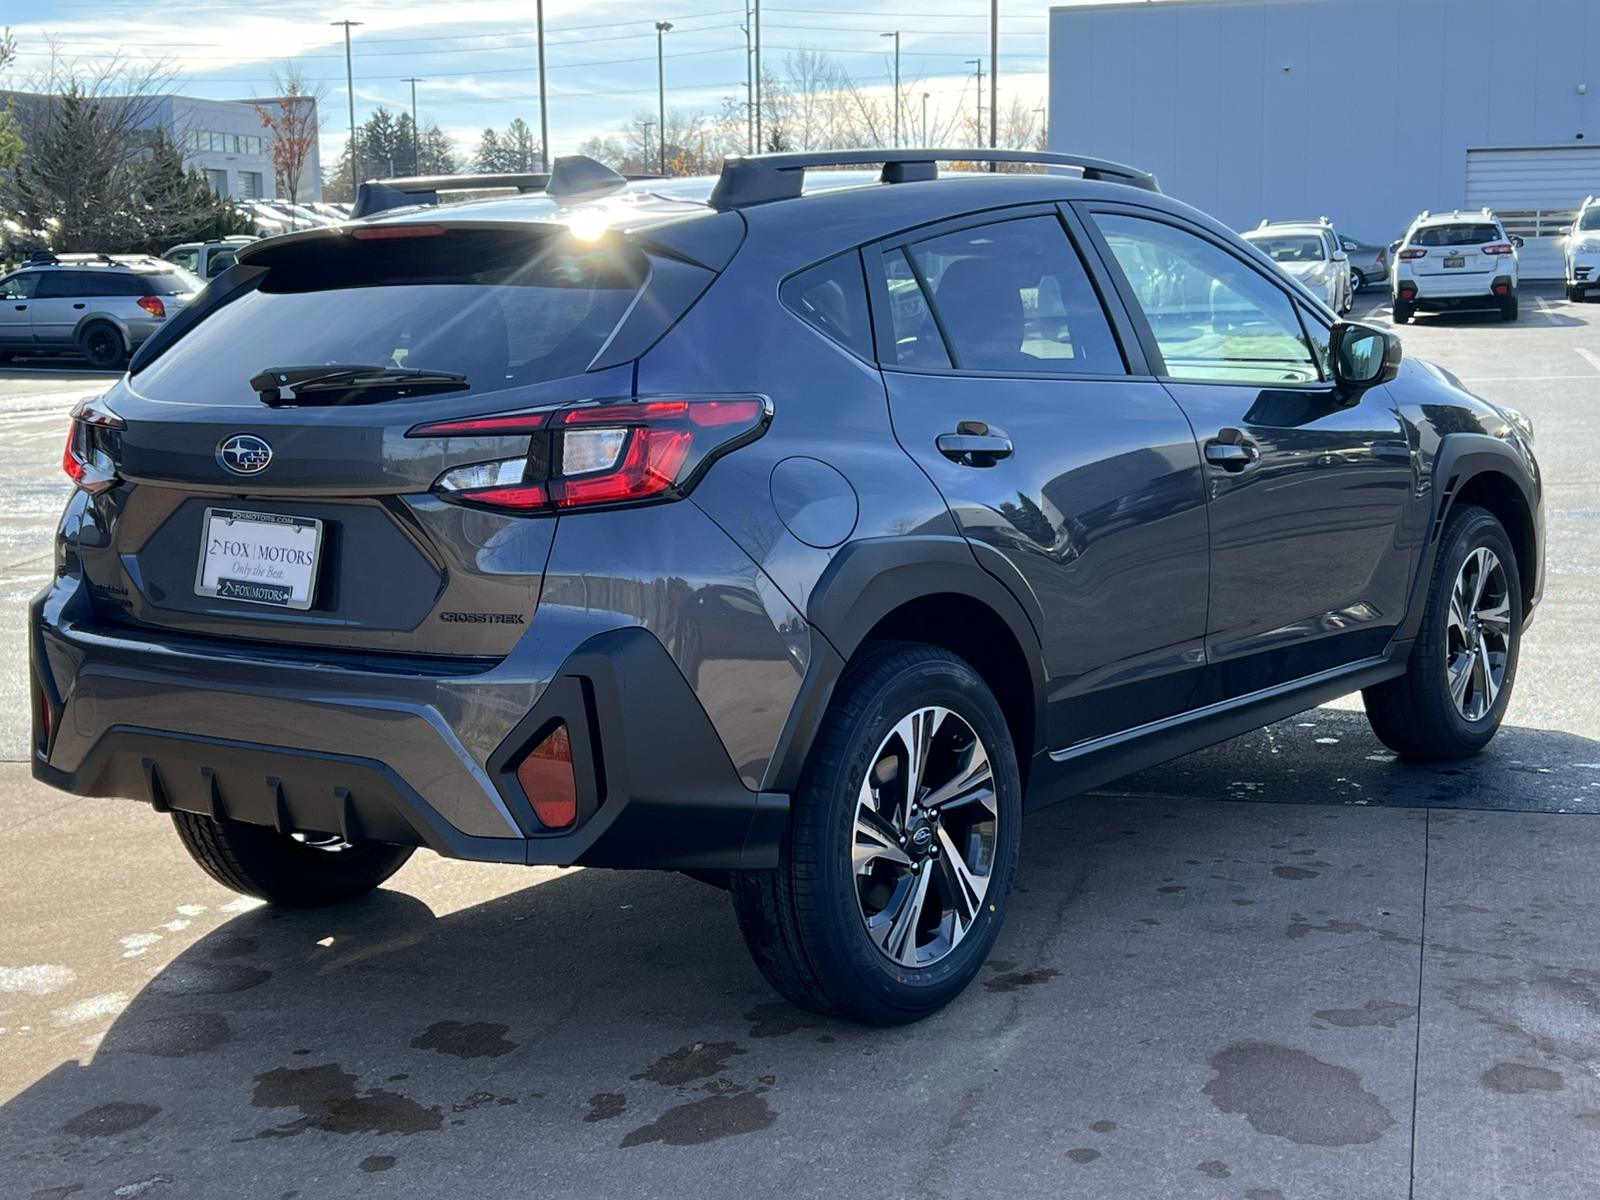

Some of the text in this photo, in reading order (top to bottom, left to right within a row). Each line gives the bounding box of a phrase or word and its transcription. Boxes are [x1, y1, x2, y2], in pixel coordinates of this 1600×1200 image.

[232, 511, 294, 524] FOXMOTORS.COM
[223, 540, 313, 567] FOX MOTORS
[232, 561, 250, 579] Only
[252, 564, 265, 577] the
[234, 585, 284, 602] FOX MOTORS
[439, 611, 525, 625] CROSSTREK
